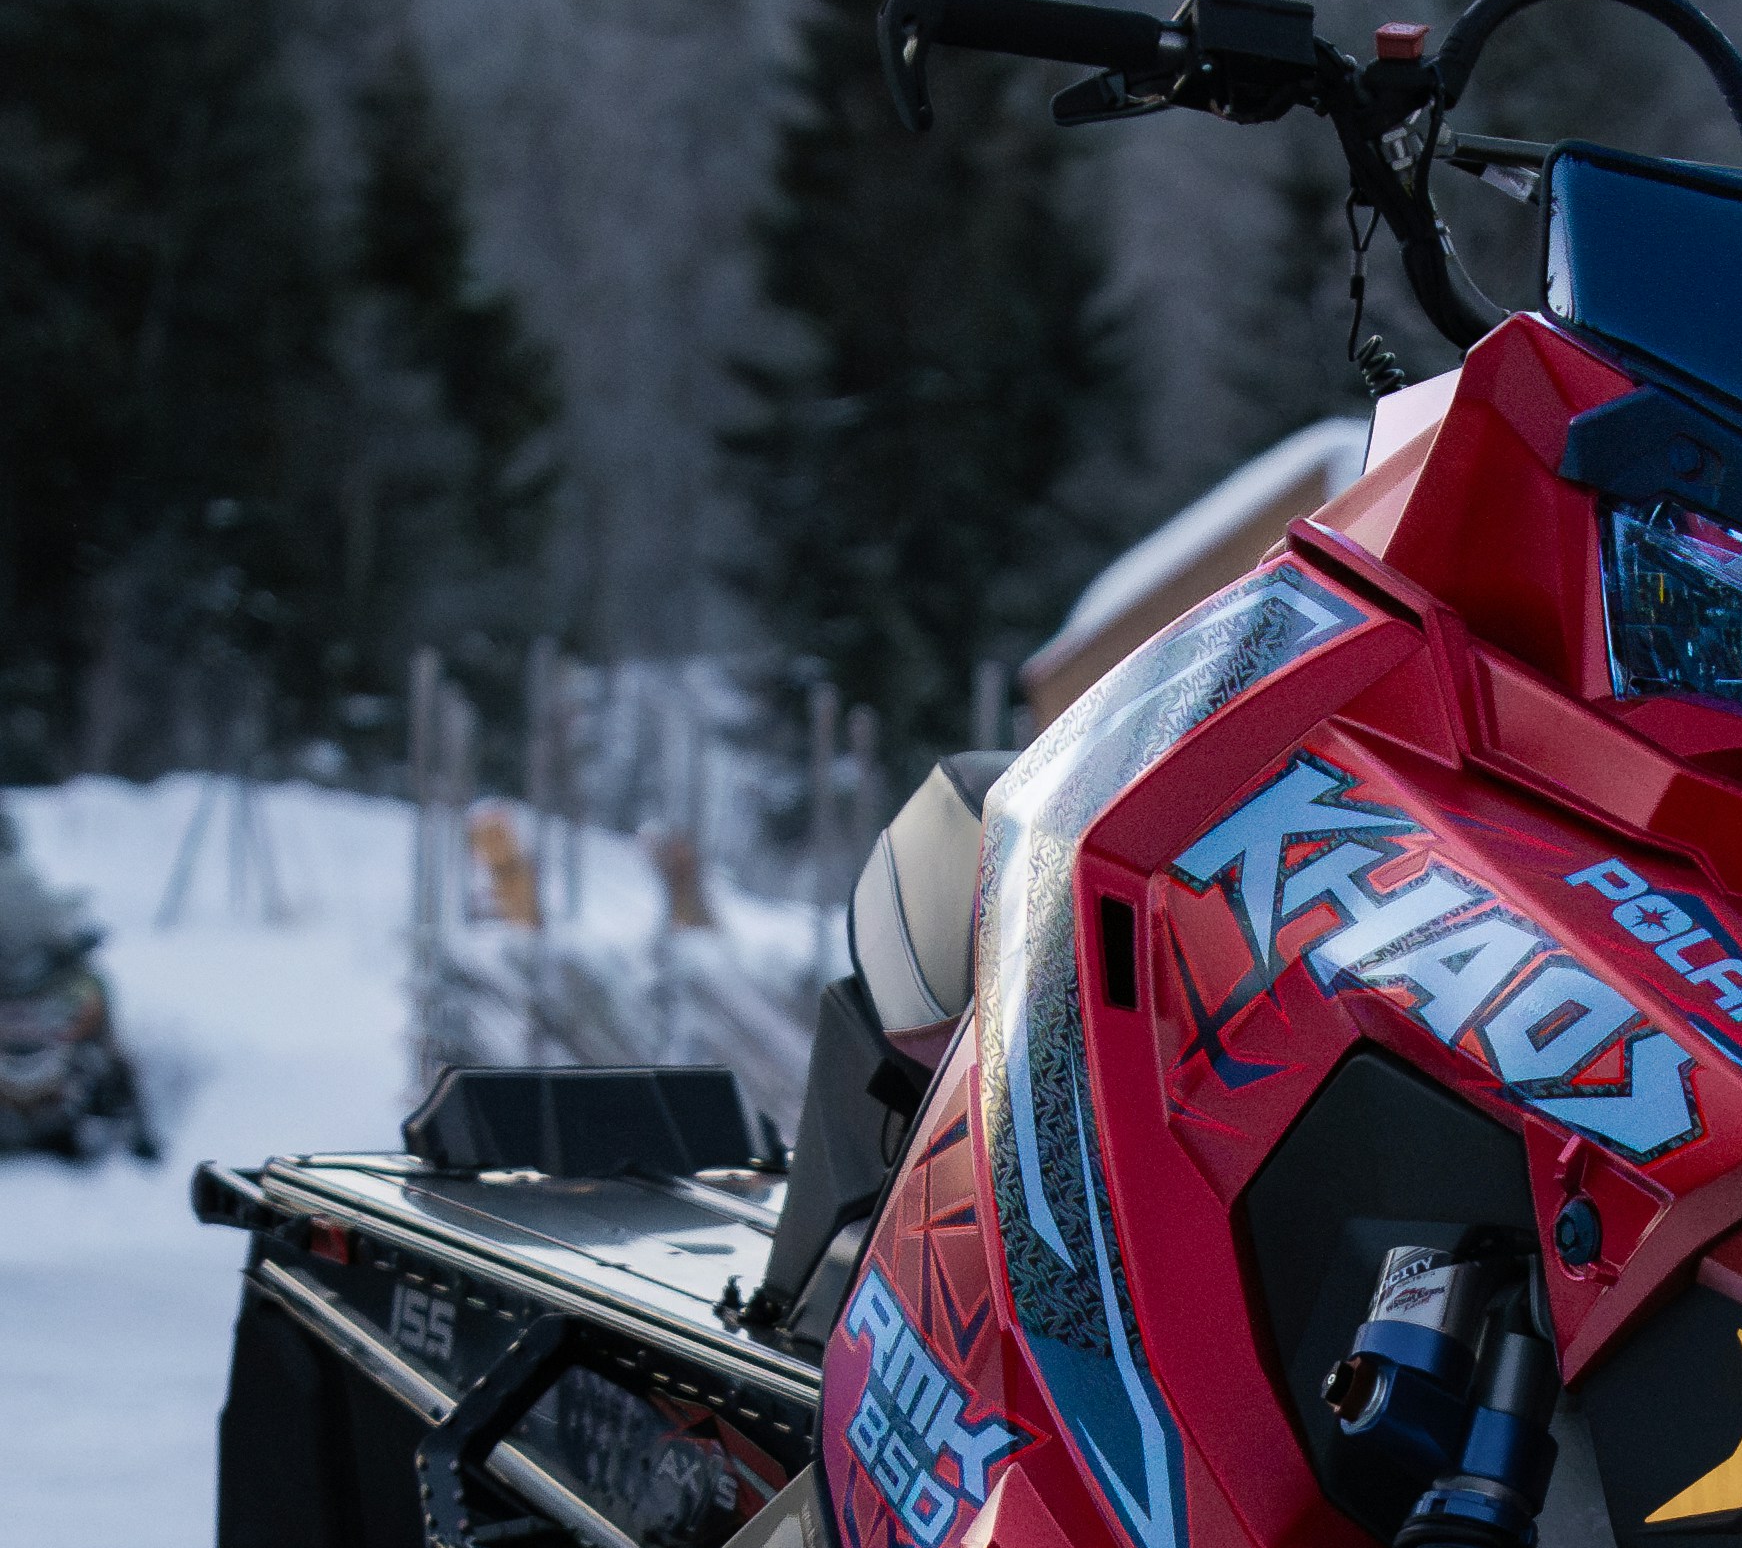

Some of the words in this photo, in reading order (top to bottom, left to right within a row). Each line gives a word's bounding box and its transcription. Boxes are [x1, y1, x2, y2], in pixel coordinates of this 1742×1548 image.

[1172, 754, 1700, 1160] KHAOS
[391, 1283, 456, 1360] 155
[847, 1269, 1020, 1503] RMK
[847, 1390, 955, 1544] 850
